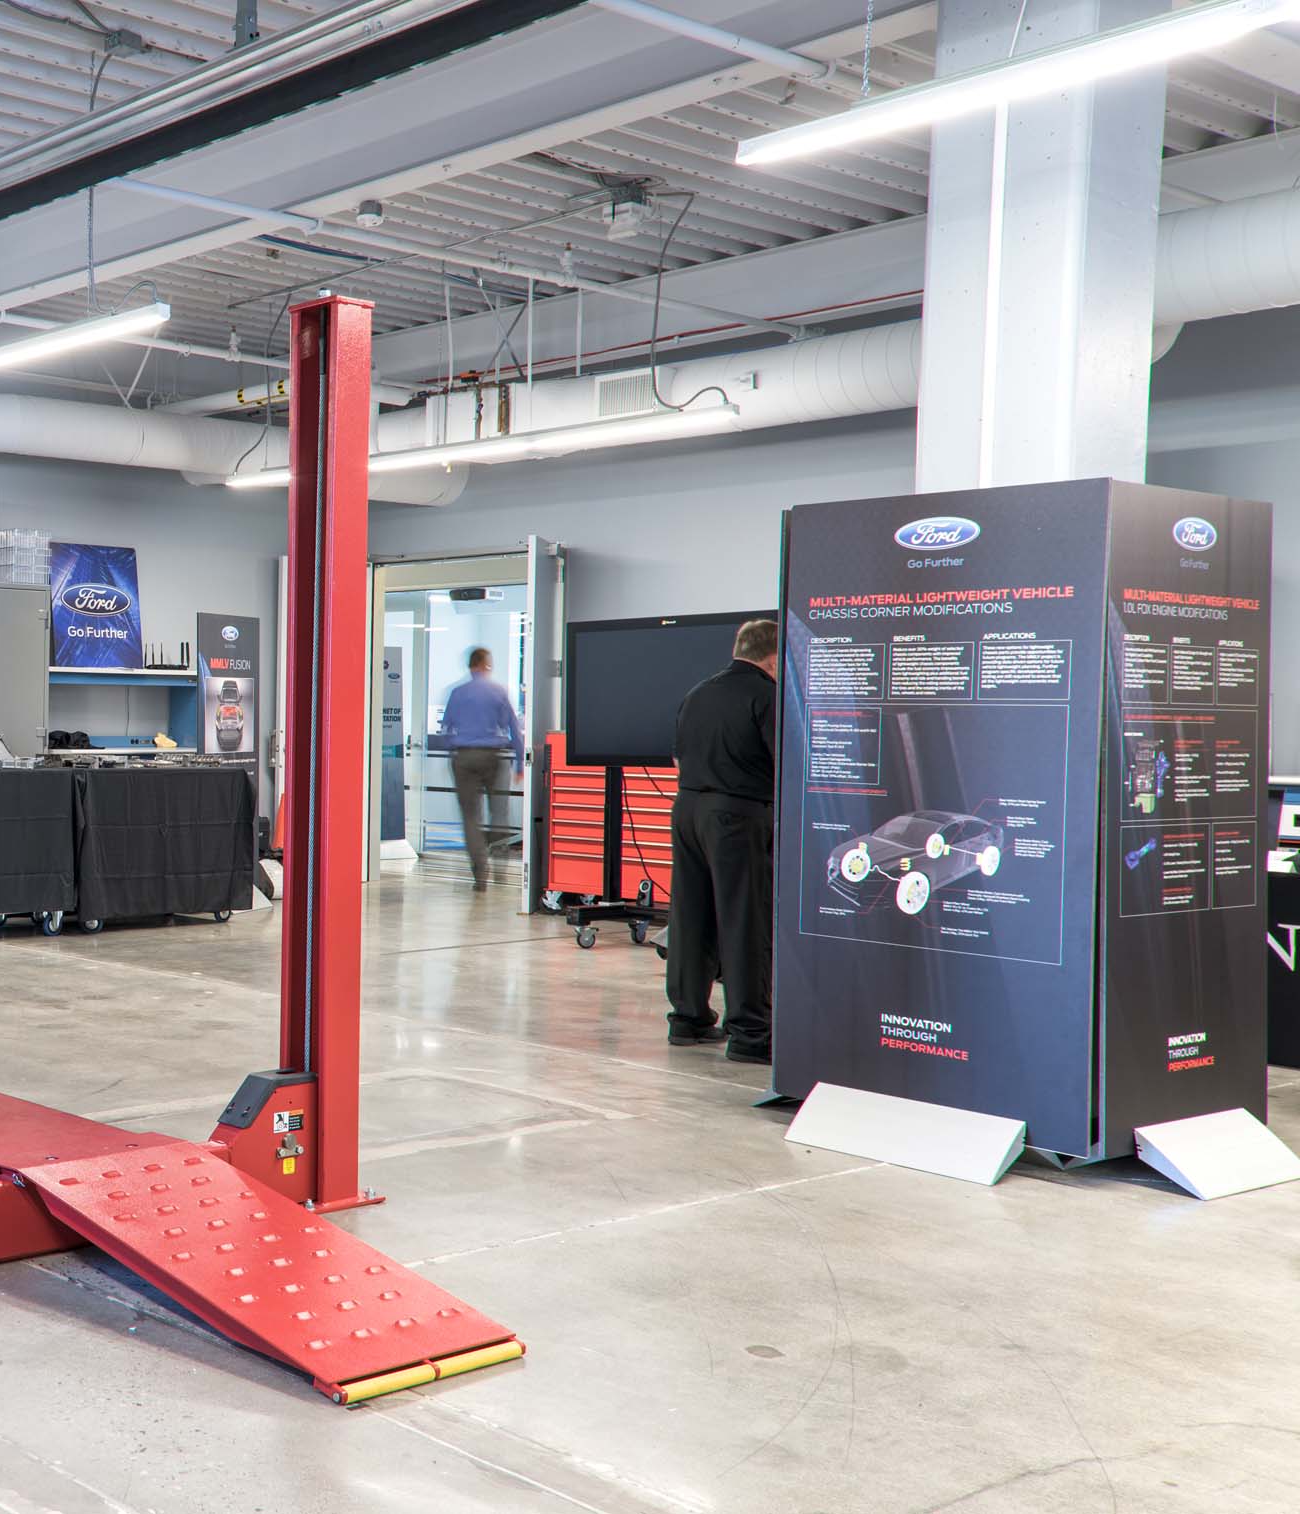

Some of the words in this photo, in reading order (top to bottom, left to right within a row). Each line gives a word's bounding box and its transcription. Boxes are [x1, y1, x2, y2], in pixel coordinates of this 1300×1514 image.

[910, 522, 963, 544] Ford
[907, 559, 923, 568] Go
[924, 557, 964, 568] Further
[75, 587, 117, 611] Ford
[809, 593, 913, 607] MULTI-MATERIAL
[915, 588, 1010, 603] LIGHTWEIGHT
[1012, 586, 1074, 600] VEHICLE
[809, 608, 858, 620] CHASSIS
[860, 606, 910, 619] CORNER
[912, 602, 1013, 616] MODIFICATIONS
[1152, 604, 1177, 616] ENGINE
[1179, 606, 1228, 620] MODIFICATIONS
[67, 626, 84, 637] Go
[86, 626, 128, 639] Further
[983, 632, 1037, 640] APPLICATIONS
[229, 658, 251, 671] FUSION
[880, 1012, 953, 1033] INNOVATION
[880, 1025, 938, 1043] THROUGH
[1168, 1032, 1207, 1047] INNOVATION
[880, 1037, 970, 1061] PERFORMANCE
[1168, 1046, 1200, 1060] THROUGH
[1168, 1055, 1215, 1072] PERFORMANCE
